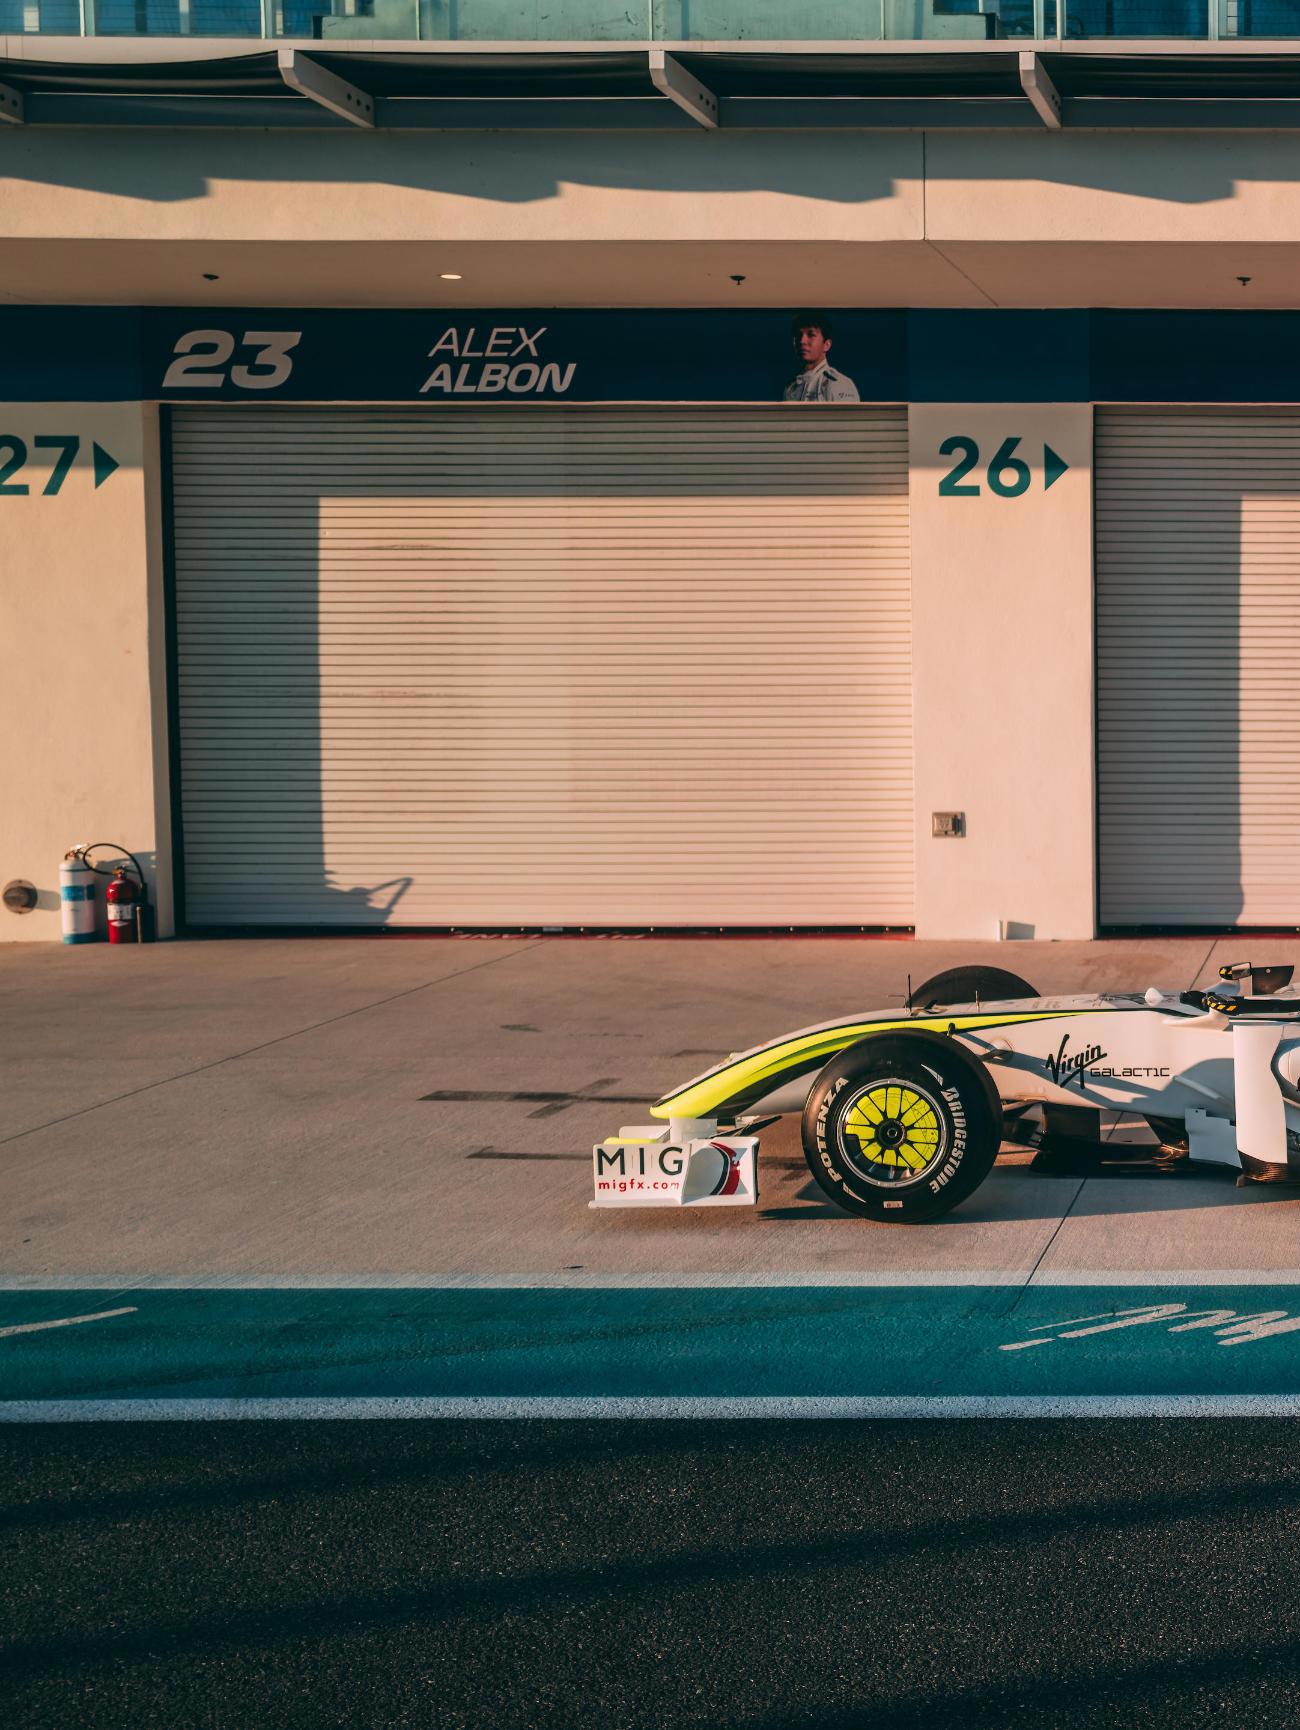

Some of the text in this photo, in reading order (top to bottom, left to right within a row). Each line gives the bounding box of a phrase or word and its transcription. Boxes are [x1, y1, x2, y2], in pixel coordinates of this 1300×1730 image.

[161, 329, 303, 389] 23
[427, 327, 548, 358] ALEX
[418, 362, 577, 393] ALBON
[0, 434, 80, 496] 27
[938, 435, 1032, 498] 26
[1045, 1033, 1108, 1090] Virgin
[816, 1076, 849, 1183] POTENZA
[927, 1086, 968, 1194] BRIDGESTONE
[598, 1178, 680, 1192] migfx.com
